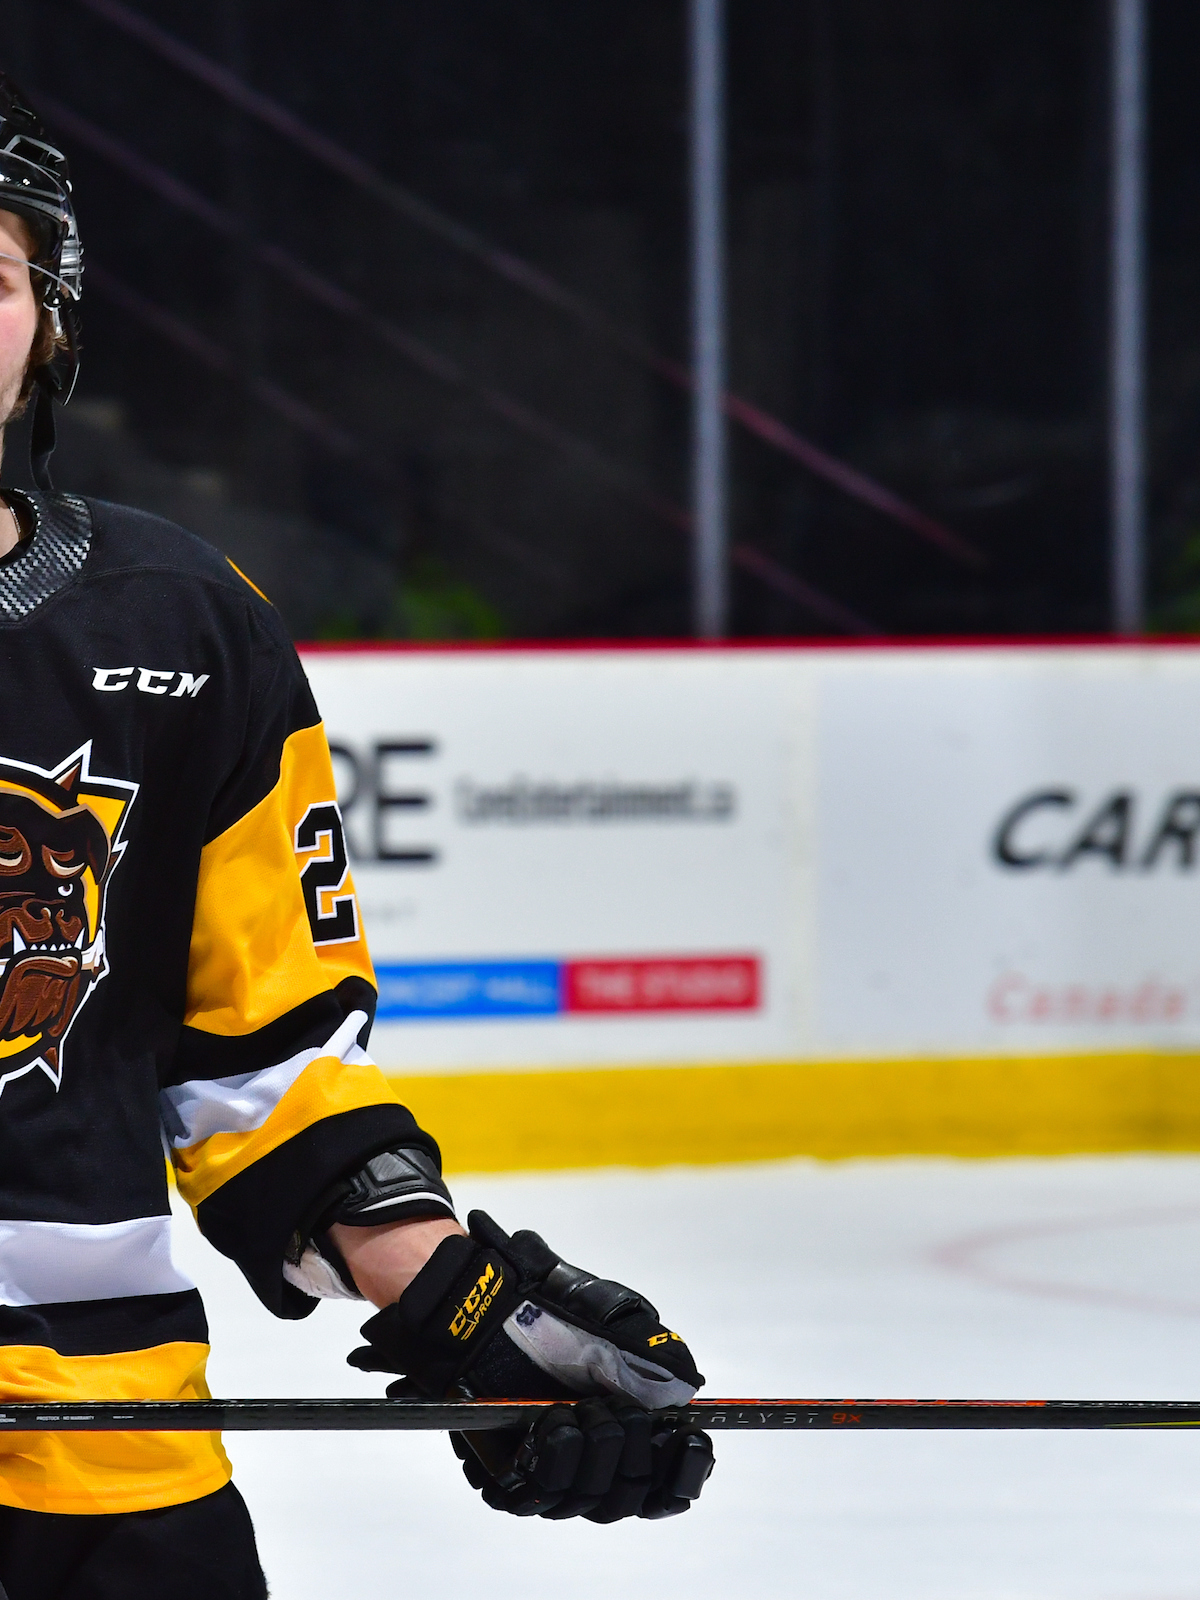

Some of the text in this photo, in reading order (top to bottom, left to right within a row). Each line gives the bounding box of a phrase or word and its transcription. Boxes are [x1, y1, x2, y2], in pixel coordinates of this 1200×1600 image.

[92, 666, 211, 698] CCM
[992, 784, 1200, 874] CAR
[447, 1262, 495, 1337] CCM
[473, 1294, 493, 1324] PRO
[649, 1411, 819, 1424] ATALYST
